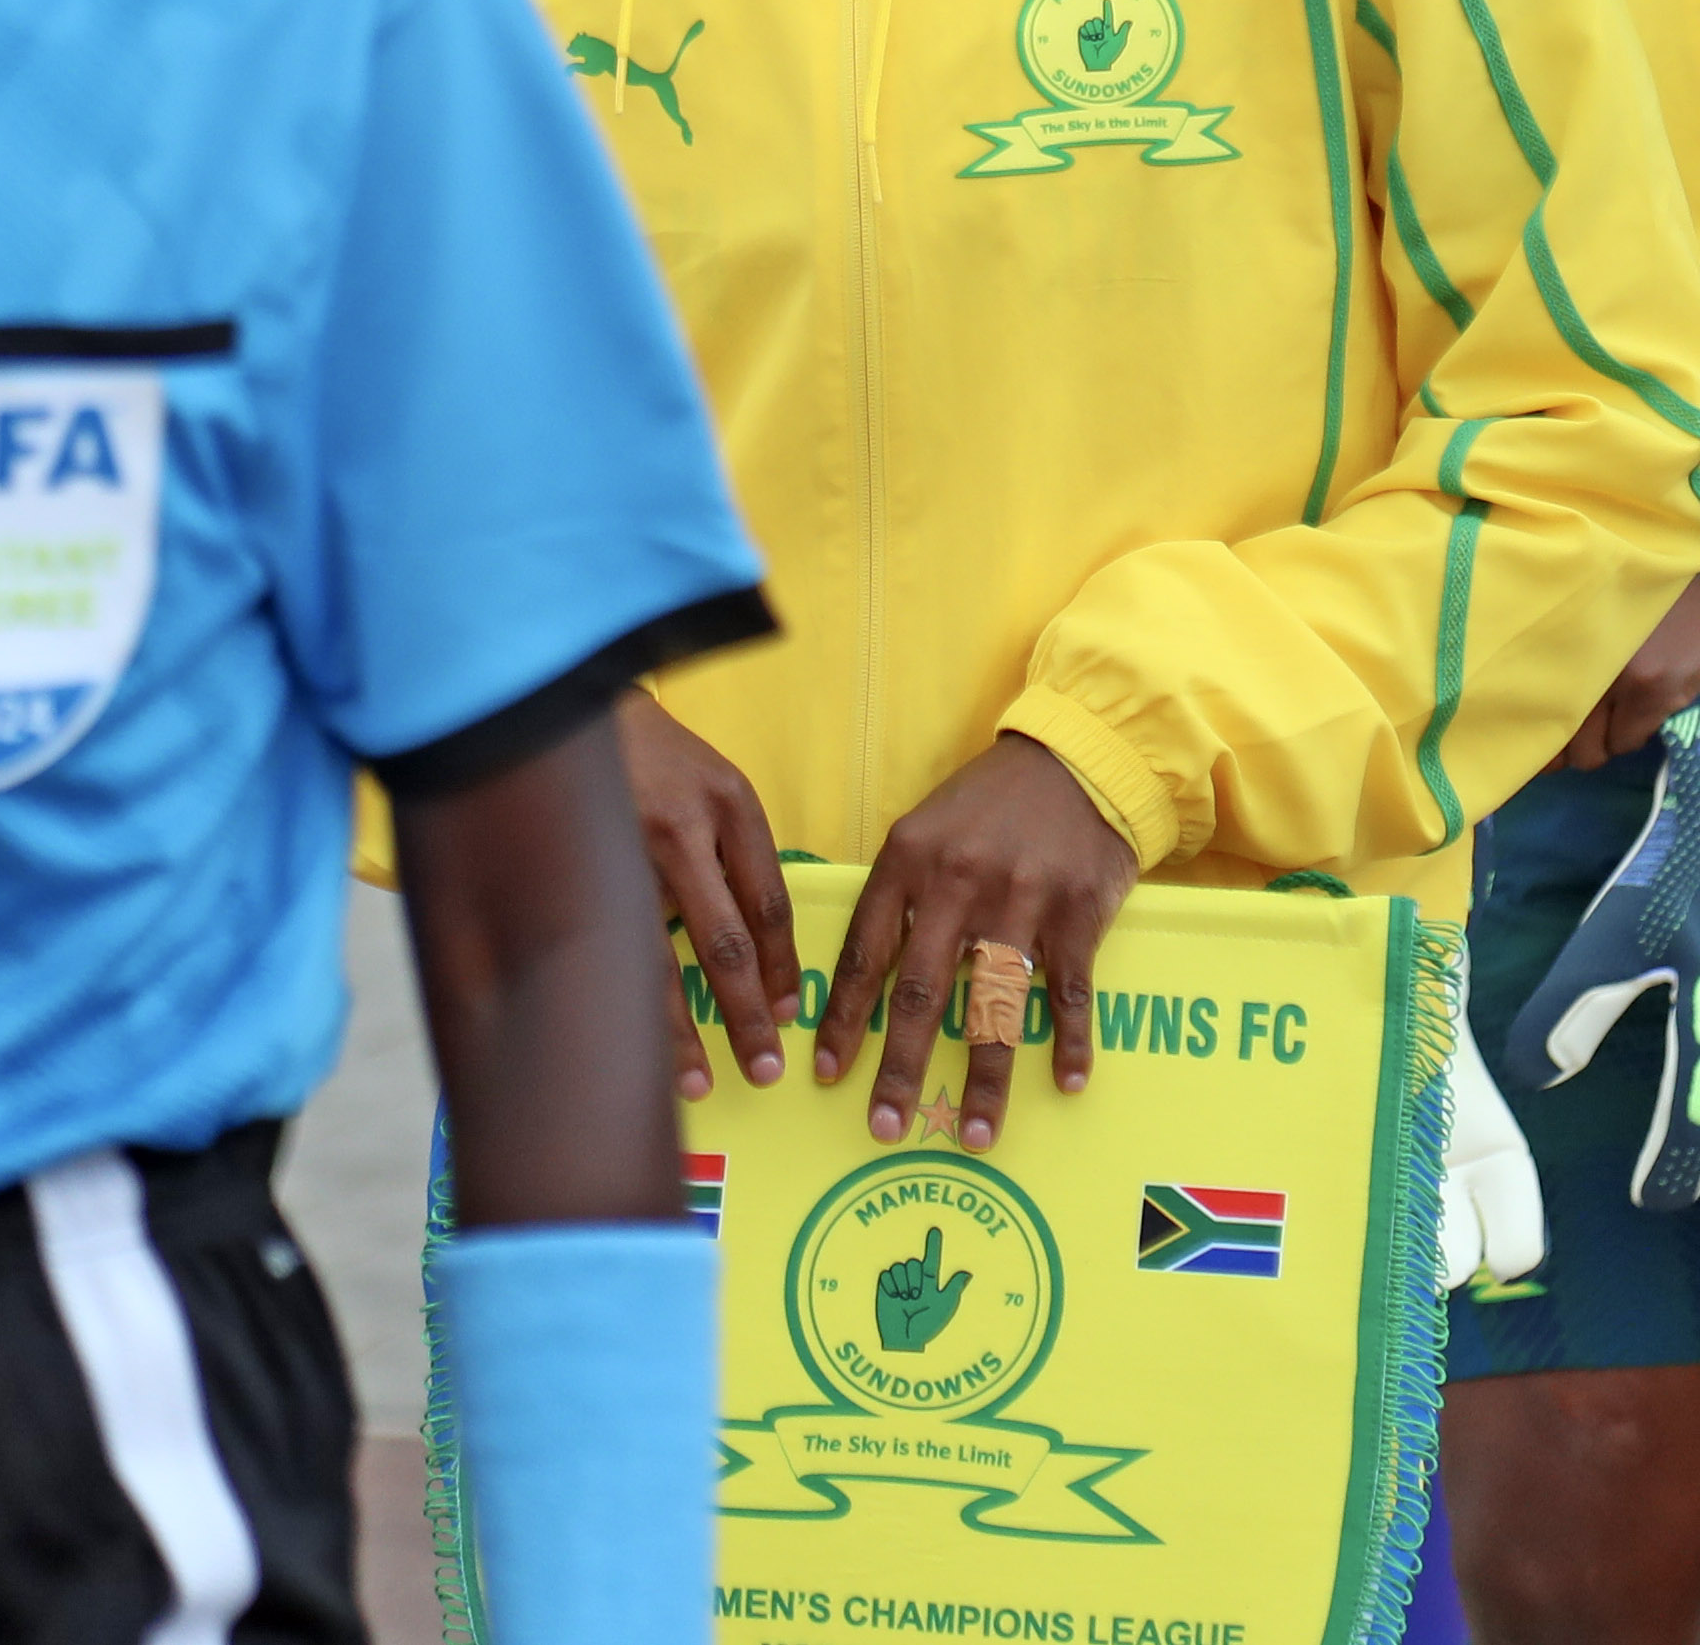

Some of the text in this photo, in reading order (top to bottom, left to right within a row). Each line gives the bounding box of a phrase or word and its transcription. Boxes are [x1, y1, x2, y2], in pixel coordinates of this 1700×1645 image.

[1051, 63, 1154, 99] SUNDOWNS
[1040, 117, 1168, 135] The Sky is the Limit
[1238, 1000, 1308, 1065] FC
[854, 1182, 1009, 1239] MAMELODI
[819, 1278, 1025, 1307] 19 70
[835, 1341, 1003, 1402] SUNDOWNS
[803, 1434, 1013, 1469] The Sky is the Limit
[713, 1586, 1245, 1645] MEN'S CHAMPIONS LEAGUE
